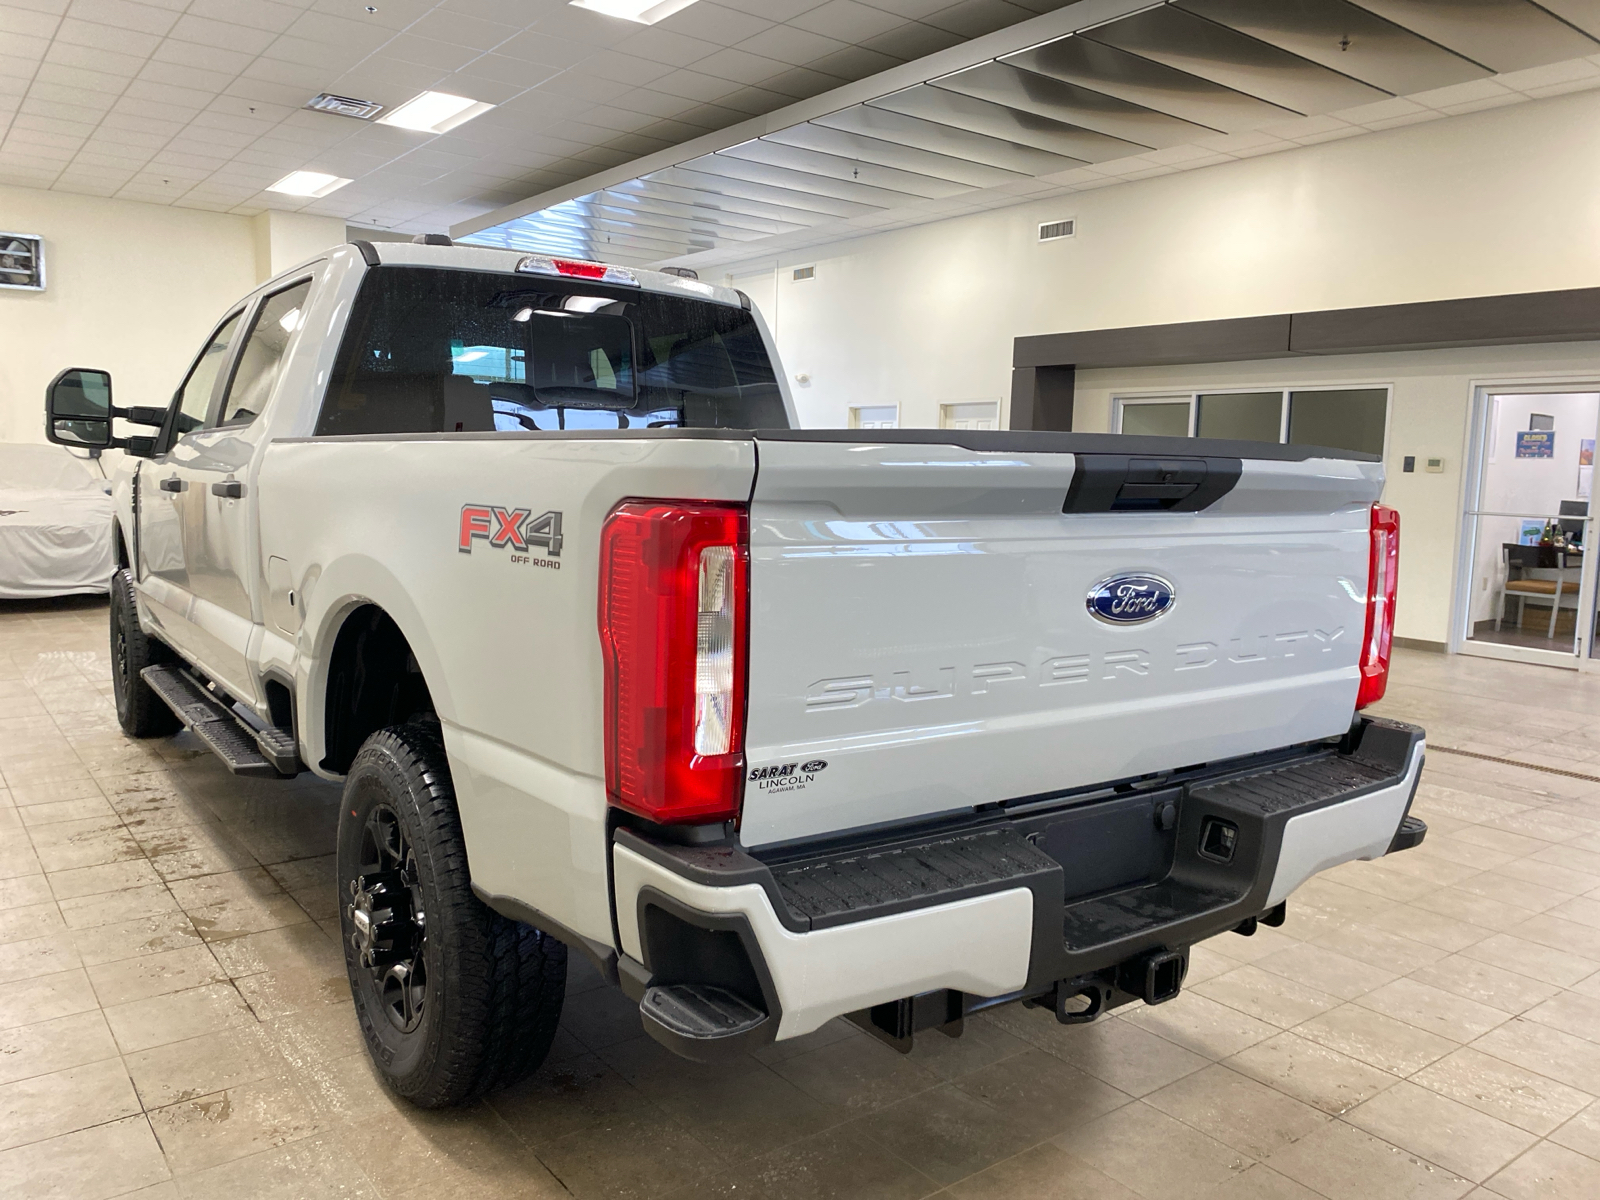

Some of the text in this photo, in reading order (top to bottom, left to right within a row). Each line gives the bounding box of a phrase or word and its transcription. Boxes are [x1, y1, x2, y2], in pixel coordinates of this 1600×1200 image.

[459, 503, 563, 557] FX4
[511, 554, 561, 570] OFF ROAD
[1111, 584, 1160, 614] Ford
[805, 626, 1344, 712] SUPER DUTY
[748, 760, 825, 781] SARAT Ford
[759, 774, 814, 789] LINCOLN
